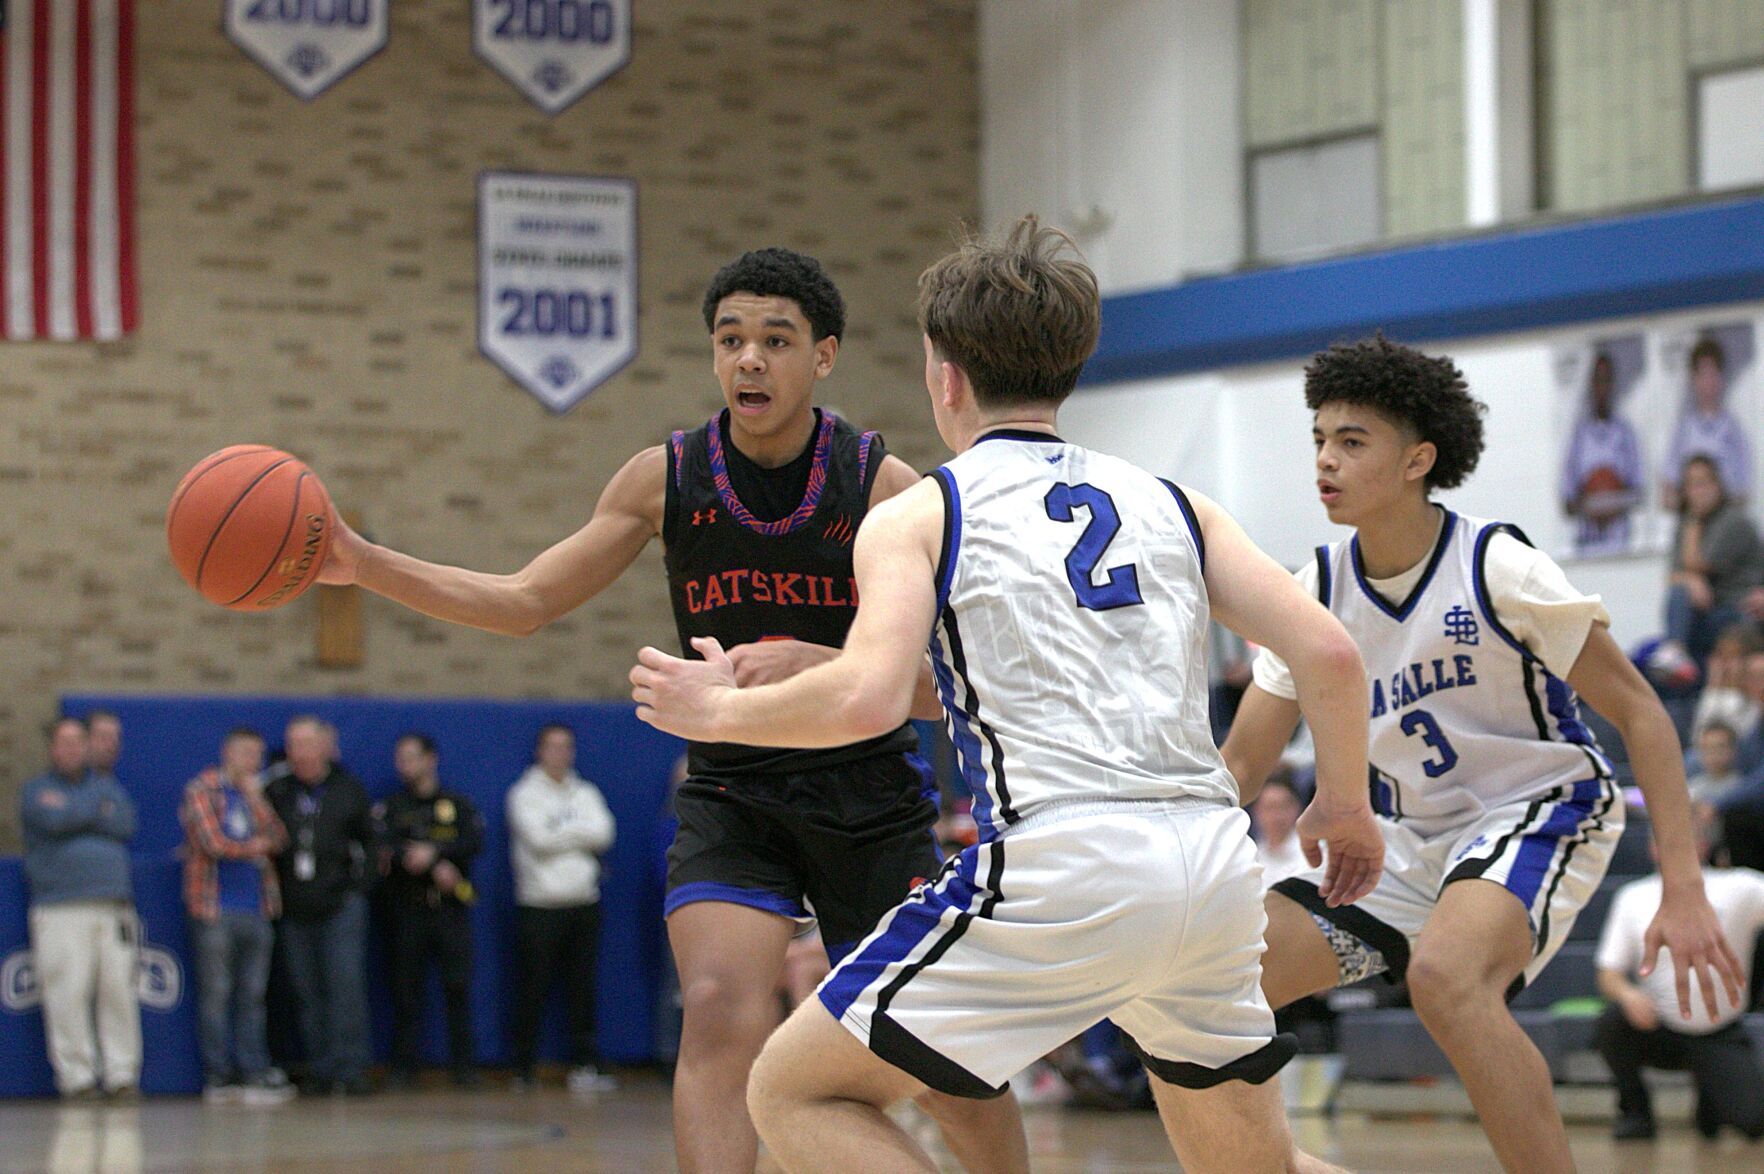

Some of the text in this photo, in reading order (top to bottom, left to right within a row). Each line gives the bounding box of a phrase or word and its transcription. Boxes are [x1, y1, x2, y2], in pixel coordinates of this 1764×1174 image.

[493, 0, 614, 44] 2000
[501, 289, 616, 340] 2001
[1043, 481, 1145, 611] 2
[1391, 654, 1477, 711] SALLE
[1400, 709, 1459, 778] 3
